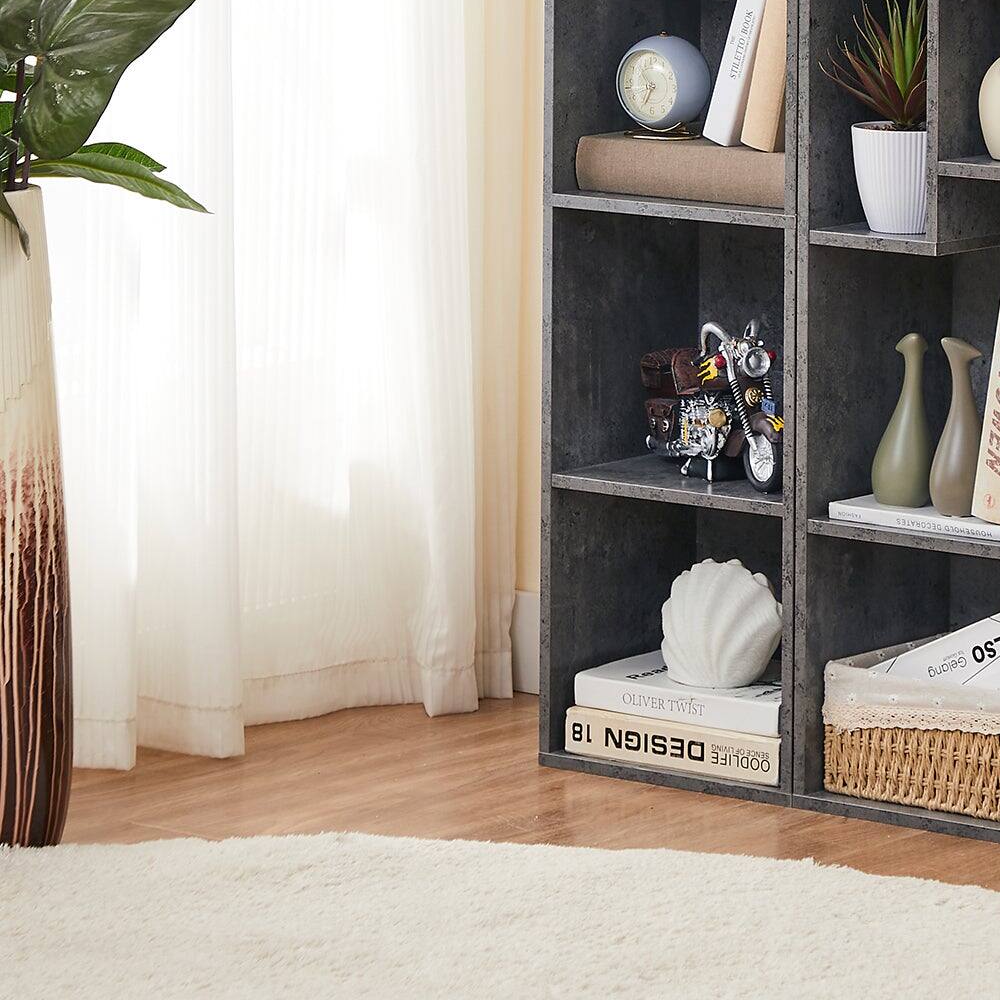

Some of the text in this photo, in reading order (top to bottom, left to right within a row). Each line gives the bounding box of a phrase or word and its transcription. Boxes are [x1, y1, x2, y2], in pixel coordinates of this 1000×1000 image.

[730, 38, 746, 80] STILETTO
[741, 9, 754, 35] BOOK
[649, 106, 655, 115] 6
[896, 517, 993, 538] HOUSEHOLD DECORATES
[927, 656, 967, 678] Gelang
[622, 692, 706, 717] OLIVER TWIST
[571, 722, 705, 762] DESIGN 18
[711, 743, 734, 753] LIVING
[711, 751, 771, 773] OODLIFE
